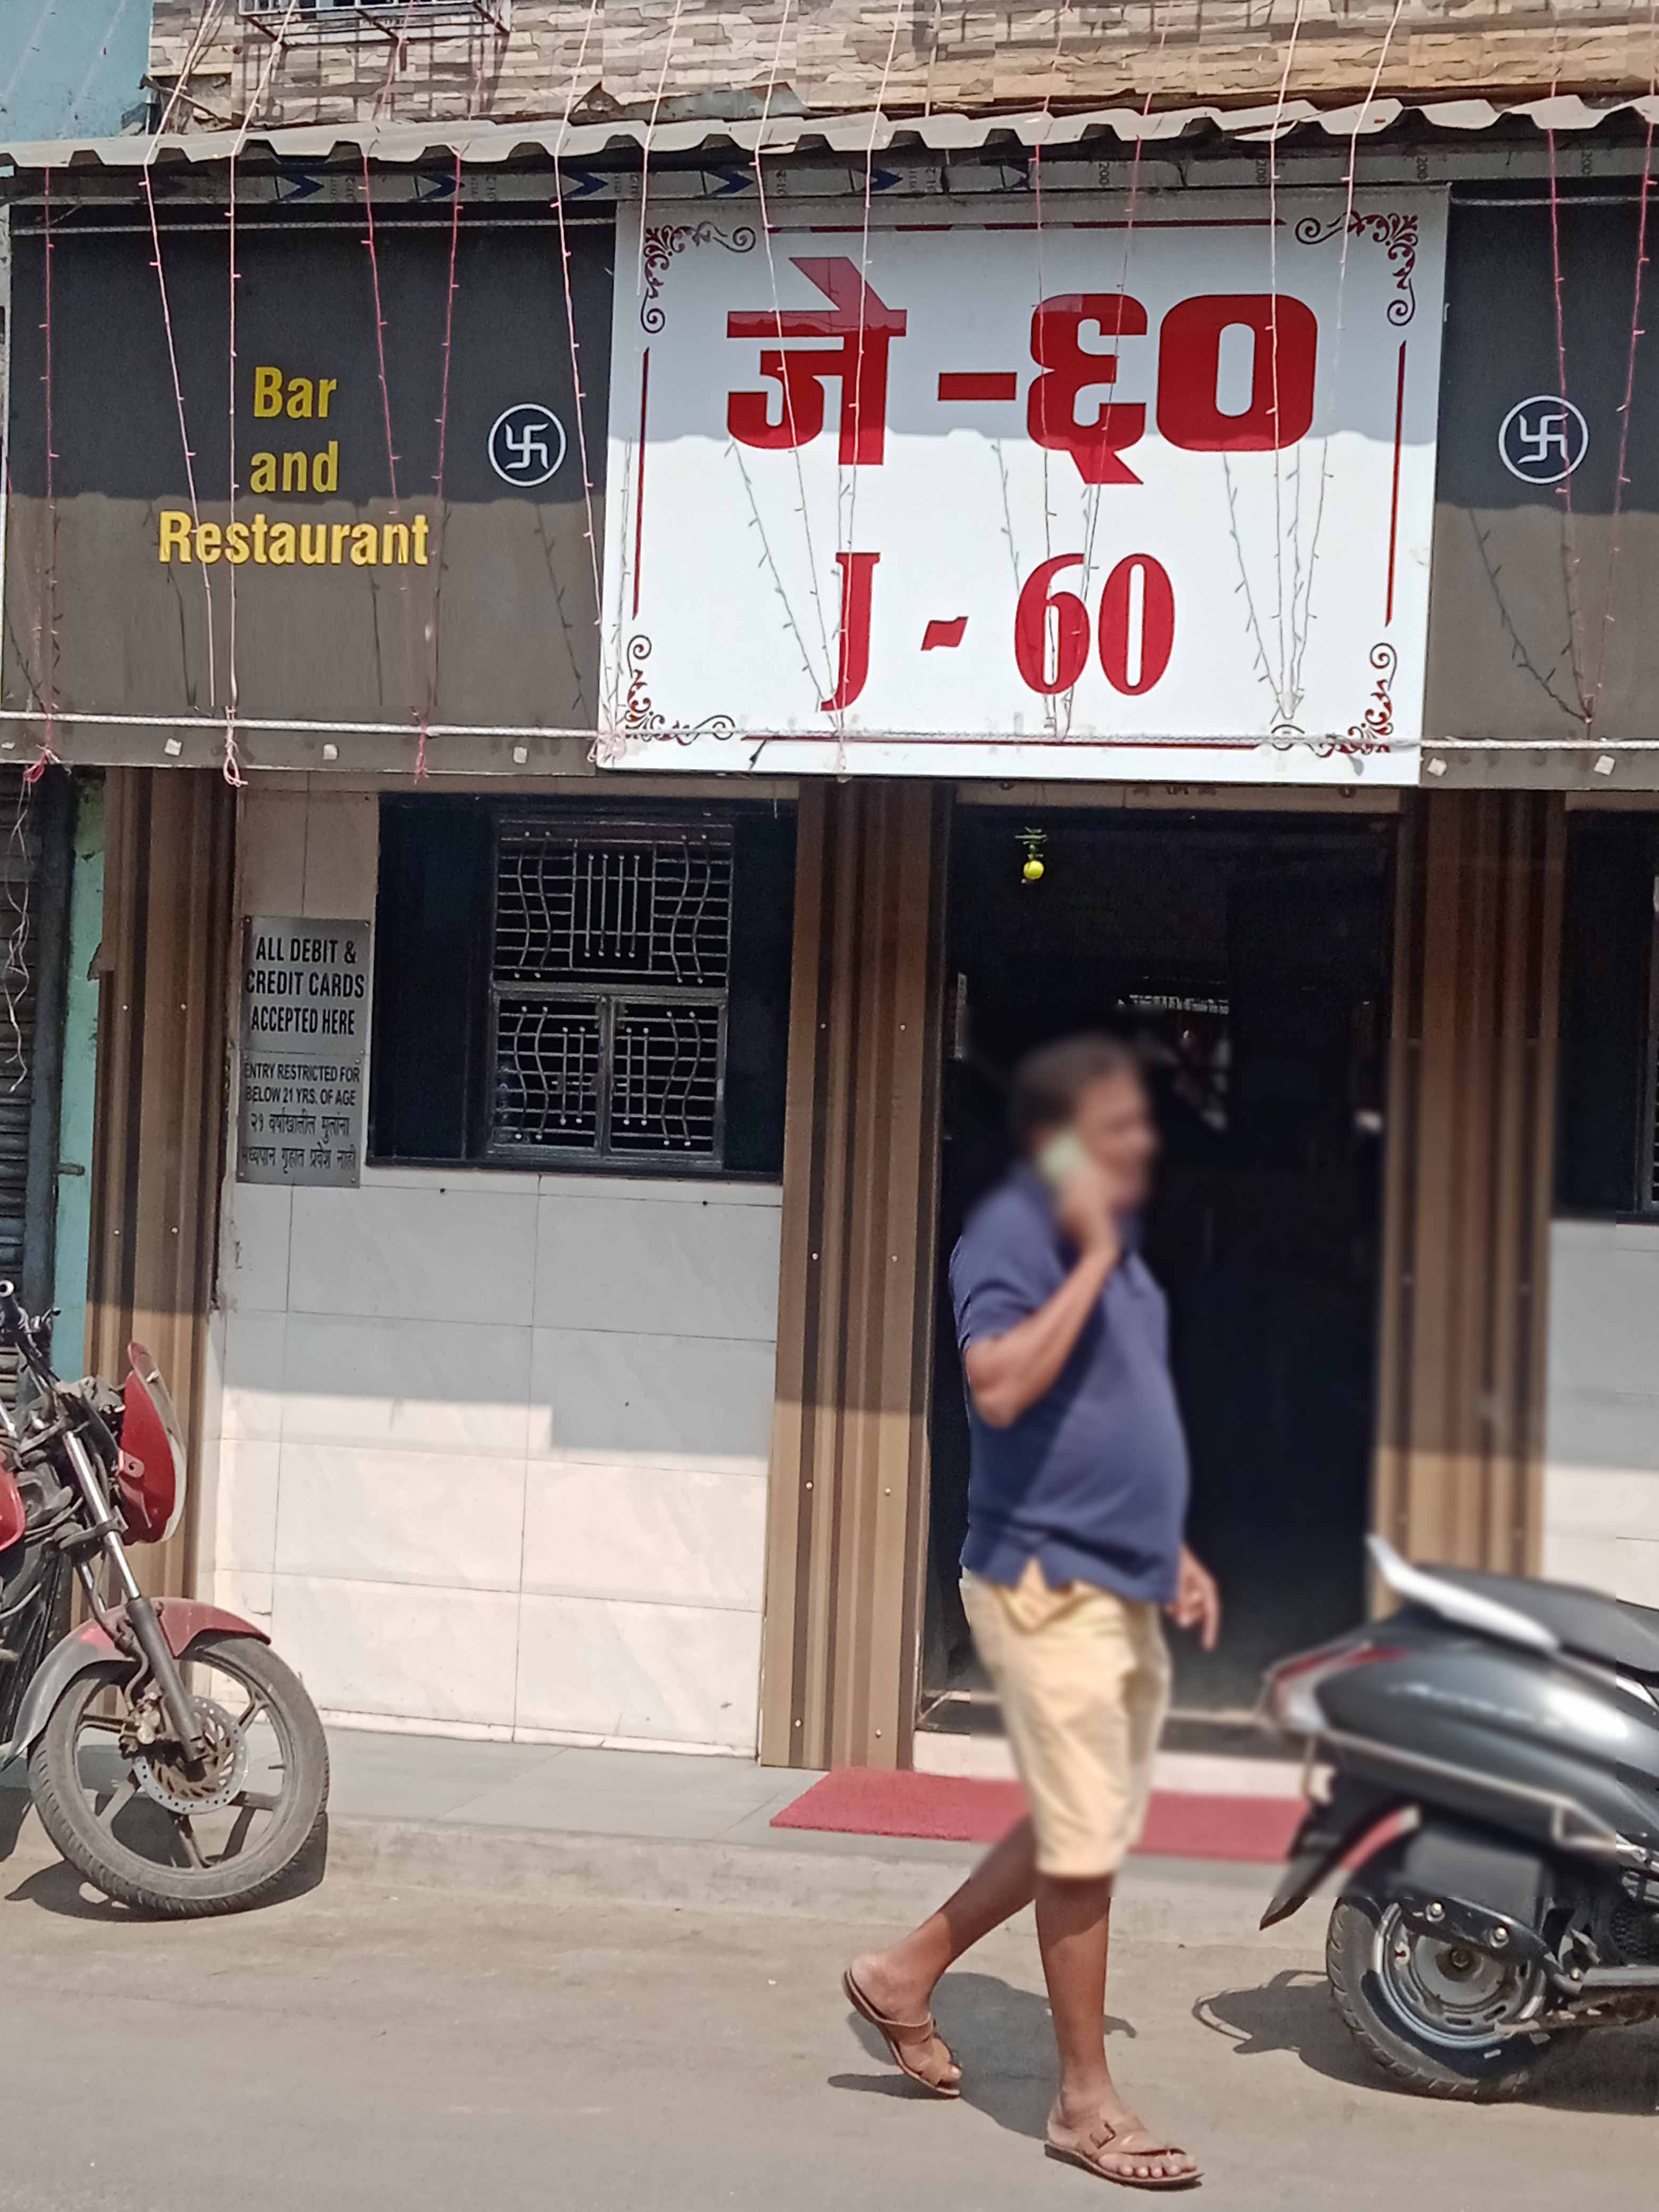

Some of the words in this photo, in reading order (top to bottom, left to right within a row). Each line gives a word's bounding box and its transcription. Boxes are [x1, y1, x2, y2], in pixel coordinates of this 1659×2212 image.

[726, 256, 908, 465] जे
[254, 366, 339, 418] Bar
[250, 441, 339, 494] and
[158, 512, 429, 566] Restaurant
[822, 552, 879, 711] J
[1015, 553, 1175, 696] 60
[256, 936, 284, 961] ALL
[290, 937, 338, 963] DEBIT
[344, 940, 357, 964] &
[246, 969, 304, 995] CREDIT
[309, 971, 365, 998] CARDS
[252, 1006, 318, 1033] ACCEPTED
[322, 1009, 355, 1035] HERE
[245, 1062, 276, 1079] ENTRY
[277, 1063, 337, 1082] RESTRICTED
[340, 1066, 361, 1083] FOR
[246, 1086, 281, 1103] BELOW
[282, 1087, 294, 1103] 21
[320, 1089, 333, 1104] OF
[334, 1090, 356, 1106] AGE
